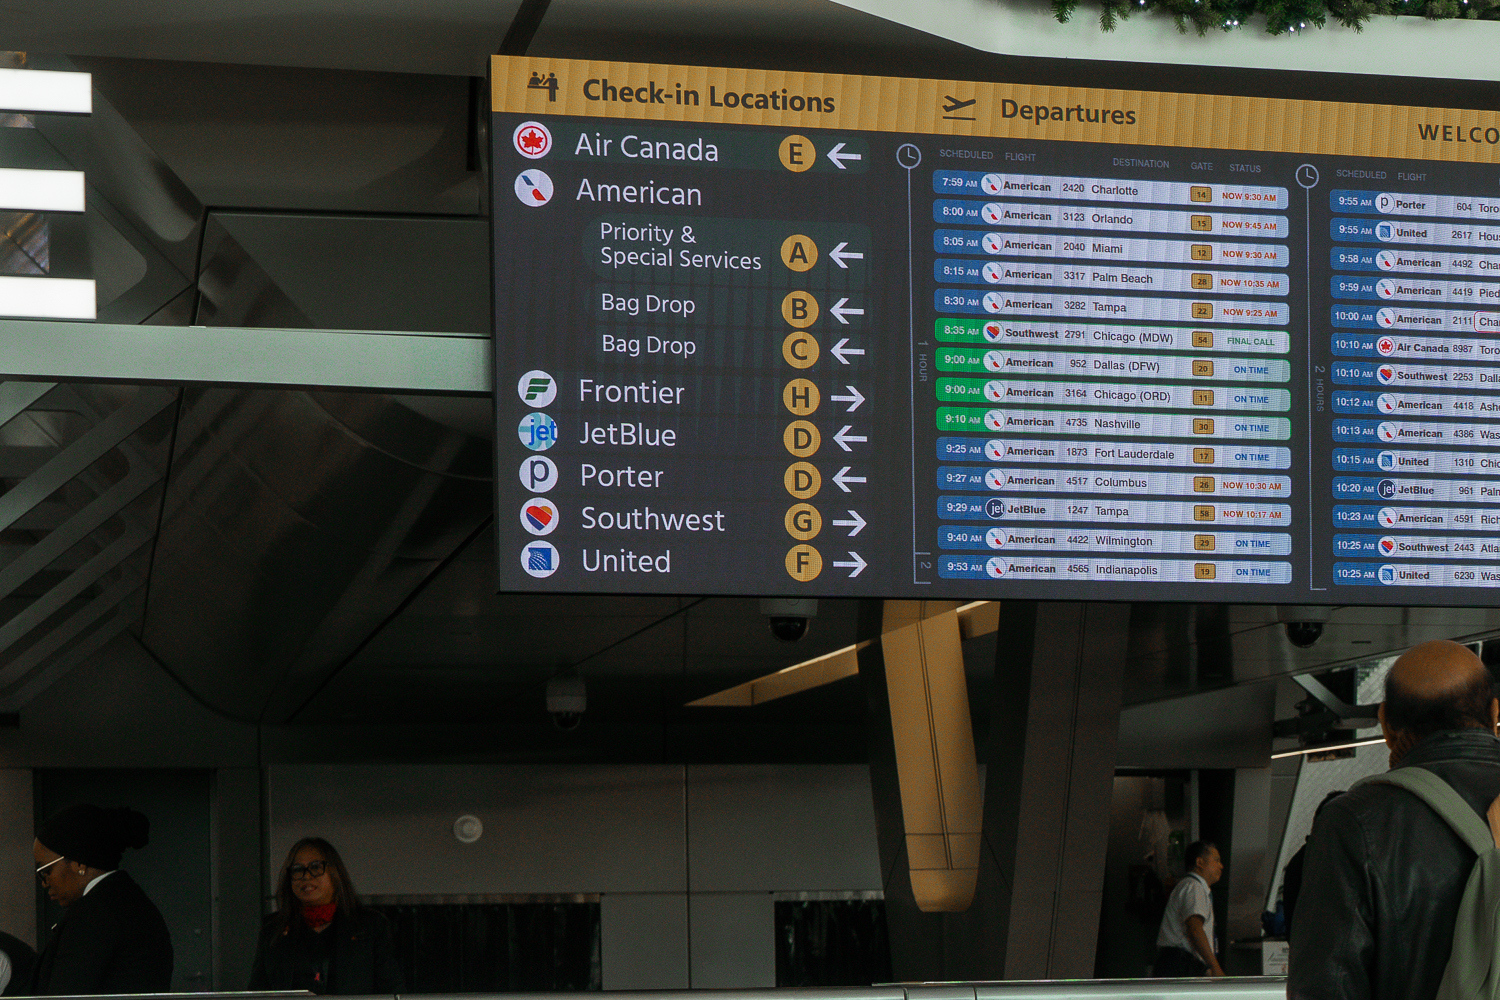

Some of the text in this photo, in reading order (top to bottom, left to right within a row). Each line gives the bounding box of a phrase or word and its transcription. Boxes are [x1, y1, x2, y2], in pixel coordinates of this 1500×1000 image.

[583, 78, 834, 114] Check-in Locations
[1001, 99, 1135, 126] Departures
[574, 132, 802, 164] Air Canada E
[940, 149, 1261, 173] SCHEDULED FLIGHT DESTINATION GATE STATUS
[576, 176, 701, 206] American
[942, 177, 963, 186] 7:59
[1003, 180, 1051, 191] American
[1063, 183, 1084, 192] 2420
[1091, 185, 1138, 196] Charlotte
[1222, 192, 1242, 200] NOW
[1244, 193, 1261, 201] 9:30
[1338, 196, 1357, 205] 9:55
[1396, 199, 1425, 209] Porter
[1456, 202, 1471, 211] 604
[600, 221, 696, 246] Priority &
[600, 245, 761, 270] Special Services
[789, 241, 807, 263] A
[601, 293, 807, 320] Bag Drop B
[1335, 311, 1358, 320] 10:00
[1397, 314, 1441, 324] American
[1452, 316, 1471, 325] 2111
[602, 334, 807, 360] Bag Drop C
[944, 325, 965, 334] 8:35
[1005, 328, 1058, 338] Southwest
[1064, 330, 1085, 339] 2791
[1093, 331, 1136, 344] Chicago
[1139, 333, 1173, 345] (MDW)
[1227, 337, 1248, 345] FINAL
[1251, 338, 1274, 346] CALL
[579, 378, 809, 408] Frontier H
[579, 420, 811, 450] JetBlue D
[581, 463, 812, 491] Porter D
[581, 505, 811, 532] Southwest G
[946, 503, 967, 512] 9:29
[1007, 504, 1045, 514] JetBlue
[1067, 506, 1087, 514] 1247
[1095, 506, 1128, 518] Tampa
[582, 548, 809, 573] United F
